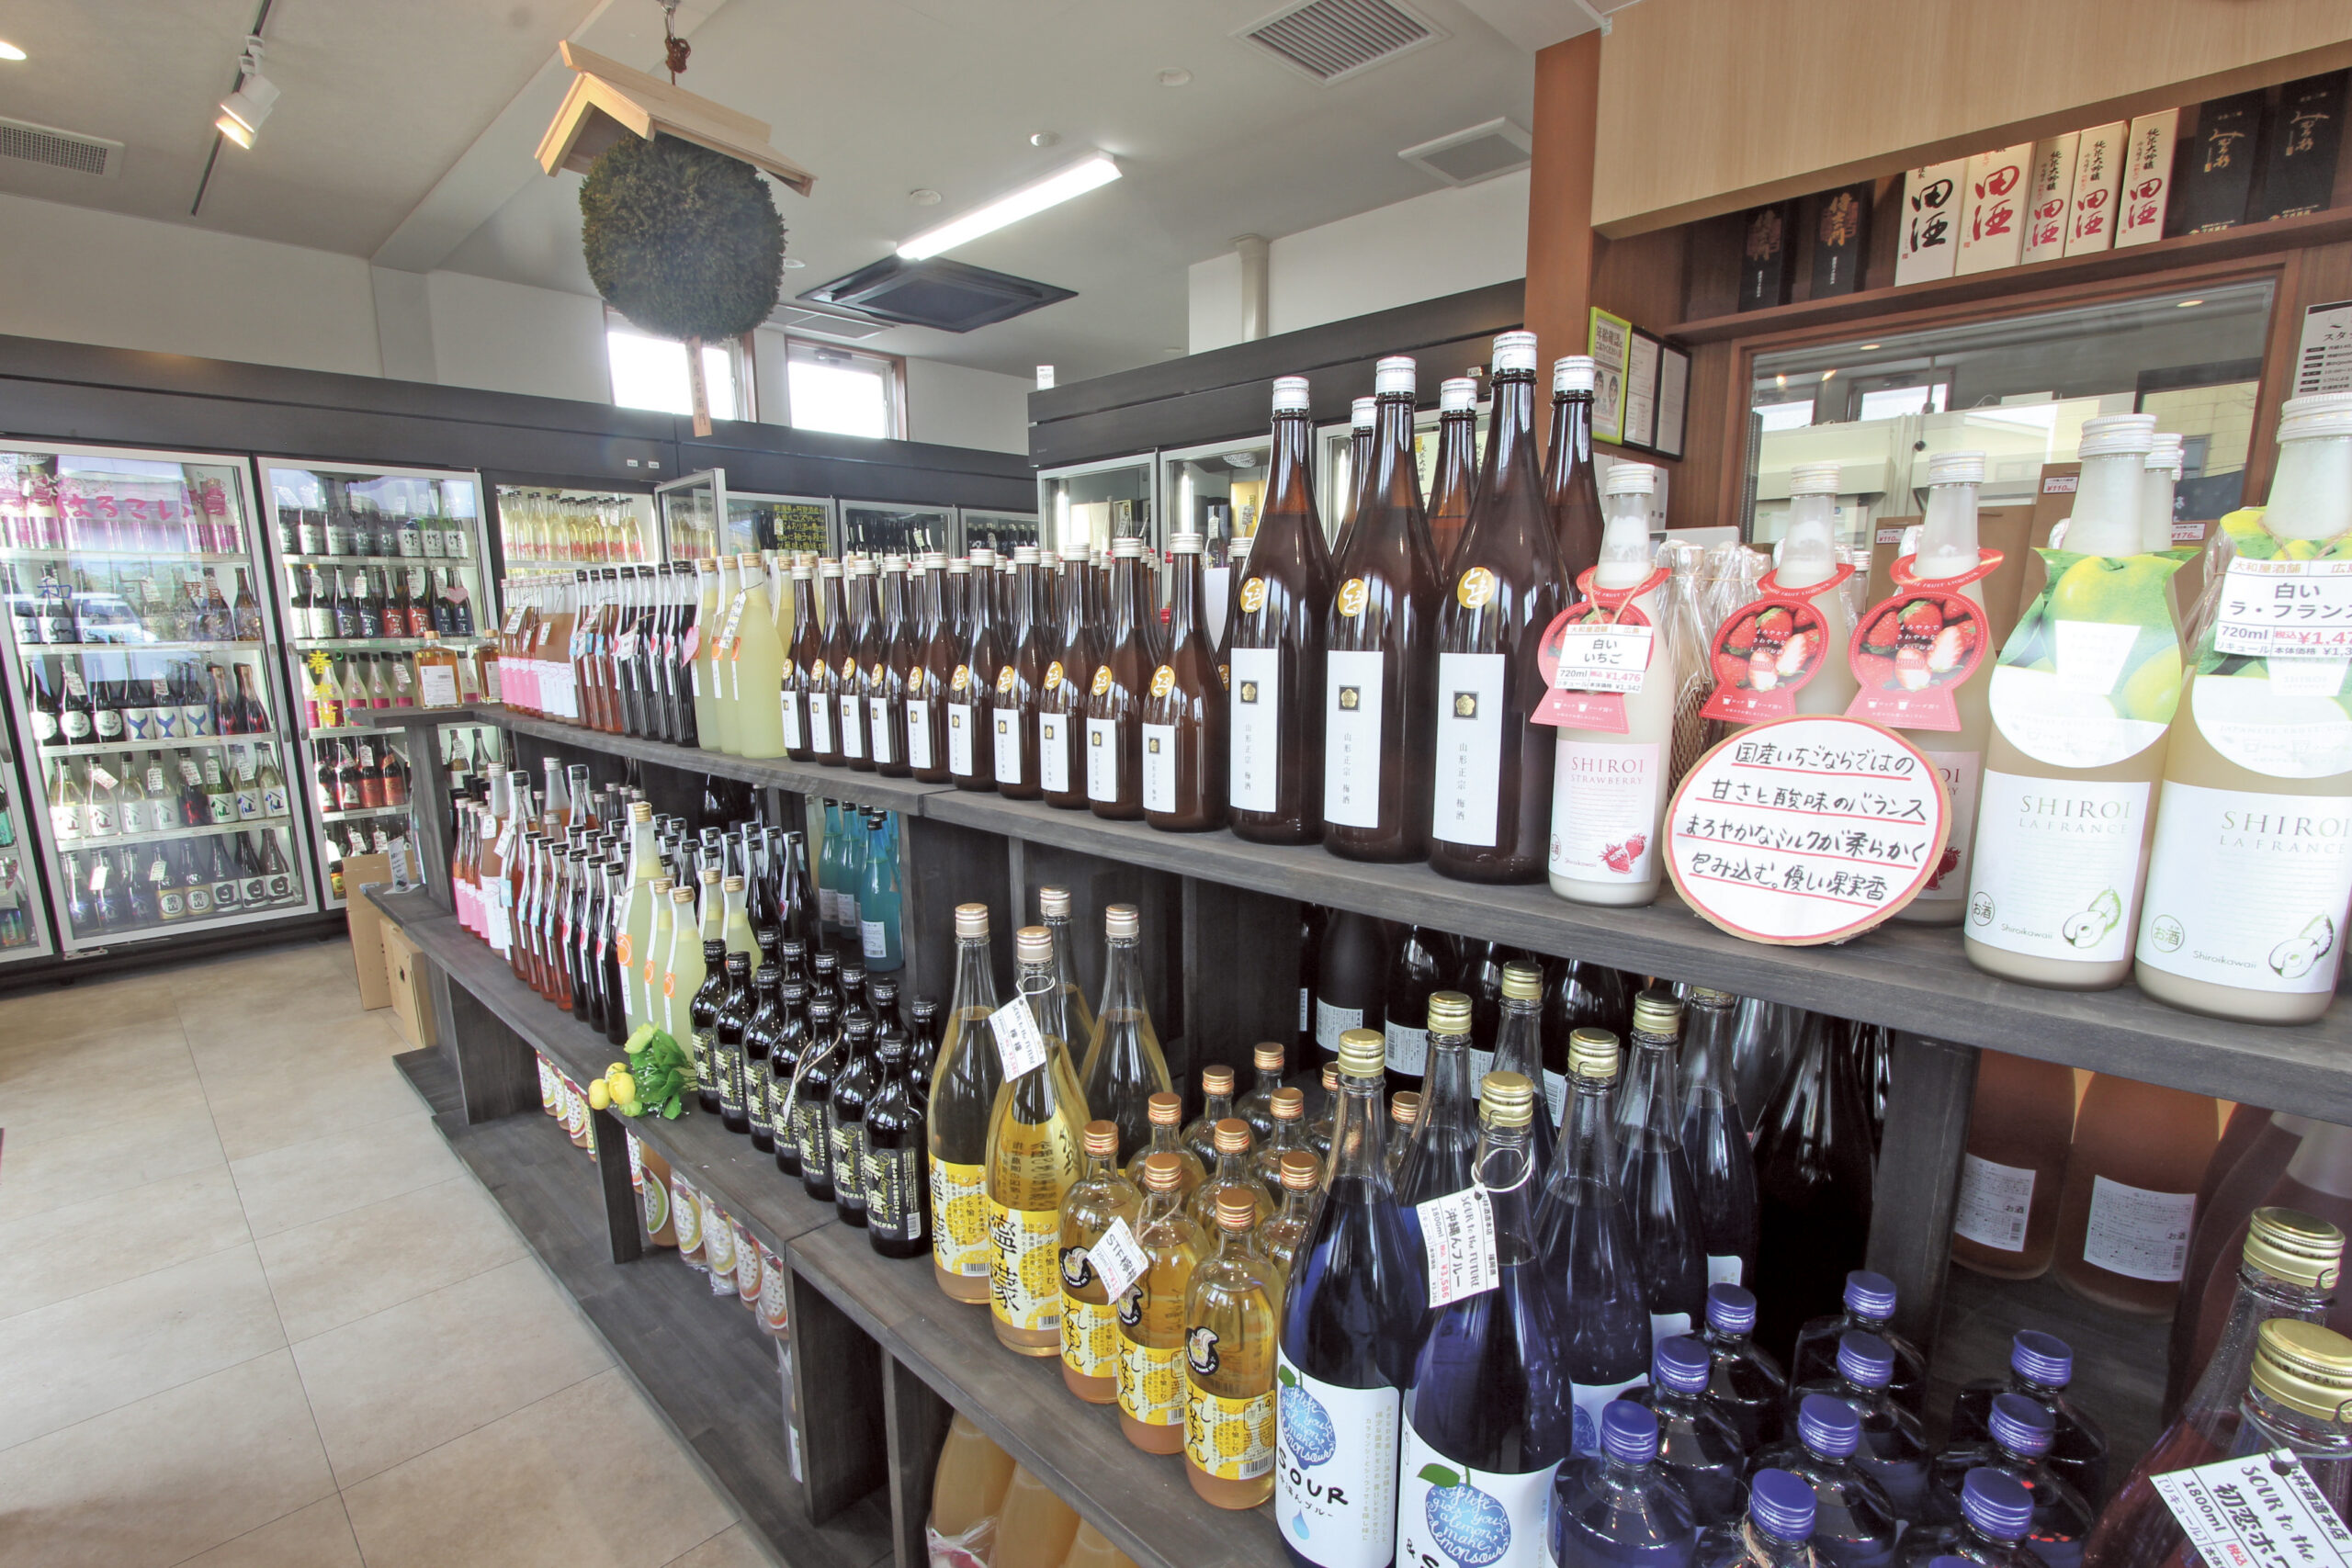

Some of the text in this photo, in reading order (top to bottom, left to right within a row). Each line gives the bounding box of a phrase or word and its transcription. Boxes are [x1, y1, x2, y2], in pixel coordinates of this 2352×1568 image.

[1910, 179, 1953, 253] 田酒
[1973, 165, 2020, 241] 田酒
[2076, 189, 2108, 239] 田酒
[2128, 178, 2162, 229] 田酒
[2032, 198, 2064, 247] 田酒
[2234, 562, 2301, 573] 大和屋酒舗
[2275, 582, 2320, 599] 白い
[1592, 638, 1617, 650] 白い
[2218, 641, 2269, 653] リキュール
[2222, 626, 2268, 639] 720ml
[1584, 652, 1623, 665] いちご
[1560, 670, 1588, 678] 720ml
[1605, 671, 1642, 682] ¥1,476
[1342, 732, 1351, 805] 山形正宗 梅酒
[1571, 756, 1645, 773] SHIROI
[1735, 742, 1916, 775] 国産いちごならではの
[1455, 742, 1468, 820] 山形正宗 梅酒
[1571, 774, 1643, 785] STRAWBERRY
[1712, 778, 1927, 821] 甘さと酸味のバランス
[2020, 795, 2131, 819] SHIROI
[1685, 813, 1926, 863] まろやかなミルクが柔らかく
[2018, 818, 2129, 834] LA FRANCE
[2222, 811, 2350, 837] SHIROI
[2220, 835, 2346, 854] LA FRANCE
[1690, 852, 1888, 901] 包み込む。優しい果実香
[2000, 922, 2052, 940] Shiroikawaii
[2192, 950, 2257, 969] Shiroikawaii
[965, 1176, 977, 1238] ソーダを愉しむ。
[1445, 1207, 1464, 1288] 沖縄んブルー
[1461, 1195, 1480, 1288] SOUR to the FUTURE
[2167, 1232, 2186, 1241] お酒
[1046, 1224, 1057, 1288] ソーダを愉しむ。
[1431, 1207, 1444, 1238] 1800ml
[1440, 1263, 1450, 1299] ¥3,586
[1257, 1399, 1272, 1412] 1:4
[1279, 1447, 1349, 1506] SOUR
[1471, 1512, 1499, 1526] you
[2182, 1480, 2248, 1567] 1800ml 税込
[2241, 1465, 2315, 1563] SOUR to the
[1444, 1526, 1491, 1551] make
